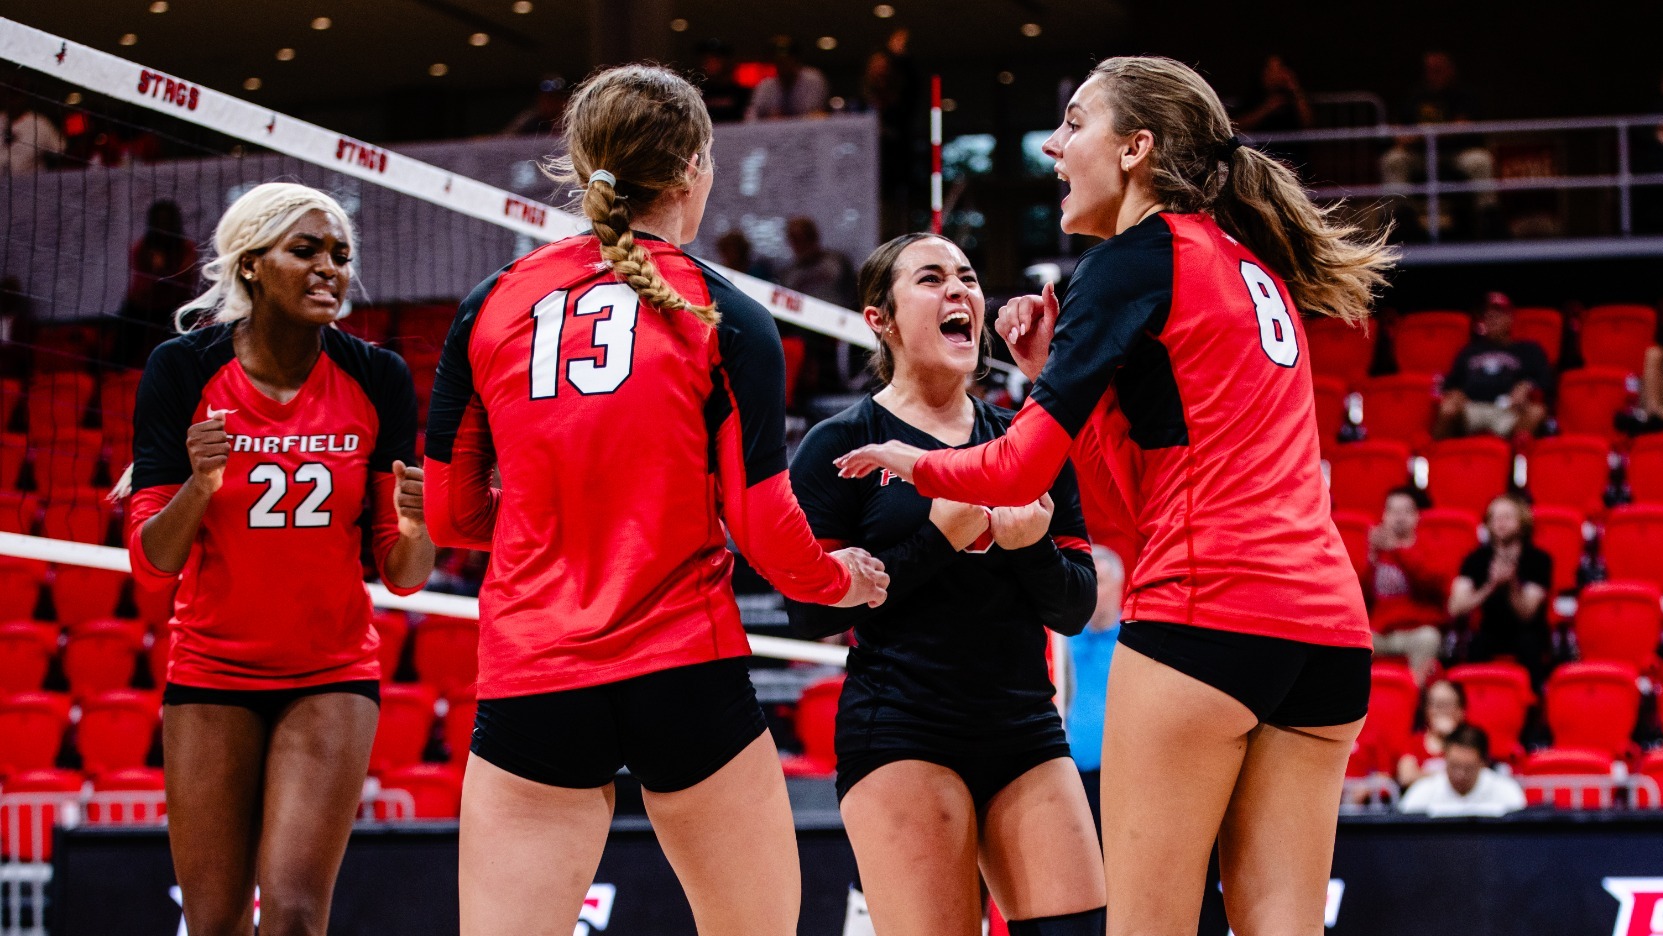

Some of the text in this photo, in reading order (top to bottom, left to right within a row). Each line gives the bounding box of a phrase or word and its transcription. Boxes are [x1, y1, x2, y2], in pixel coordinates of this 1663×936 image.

[137, 69, 199, 111] STAGS
[530, 282, 639, 399] 13
[1239, 258, 1299, 368] 8
[226, 434, 359, 453] AIRFIELD
[248, 461, 333, 529] 22
